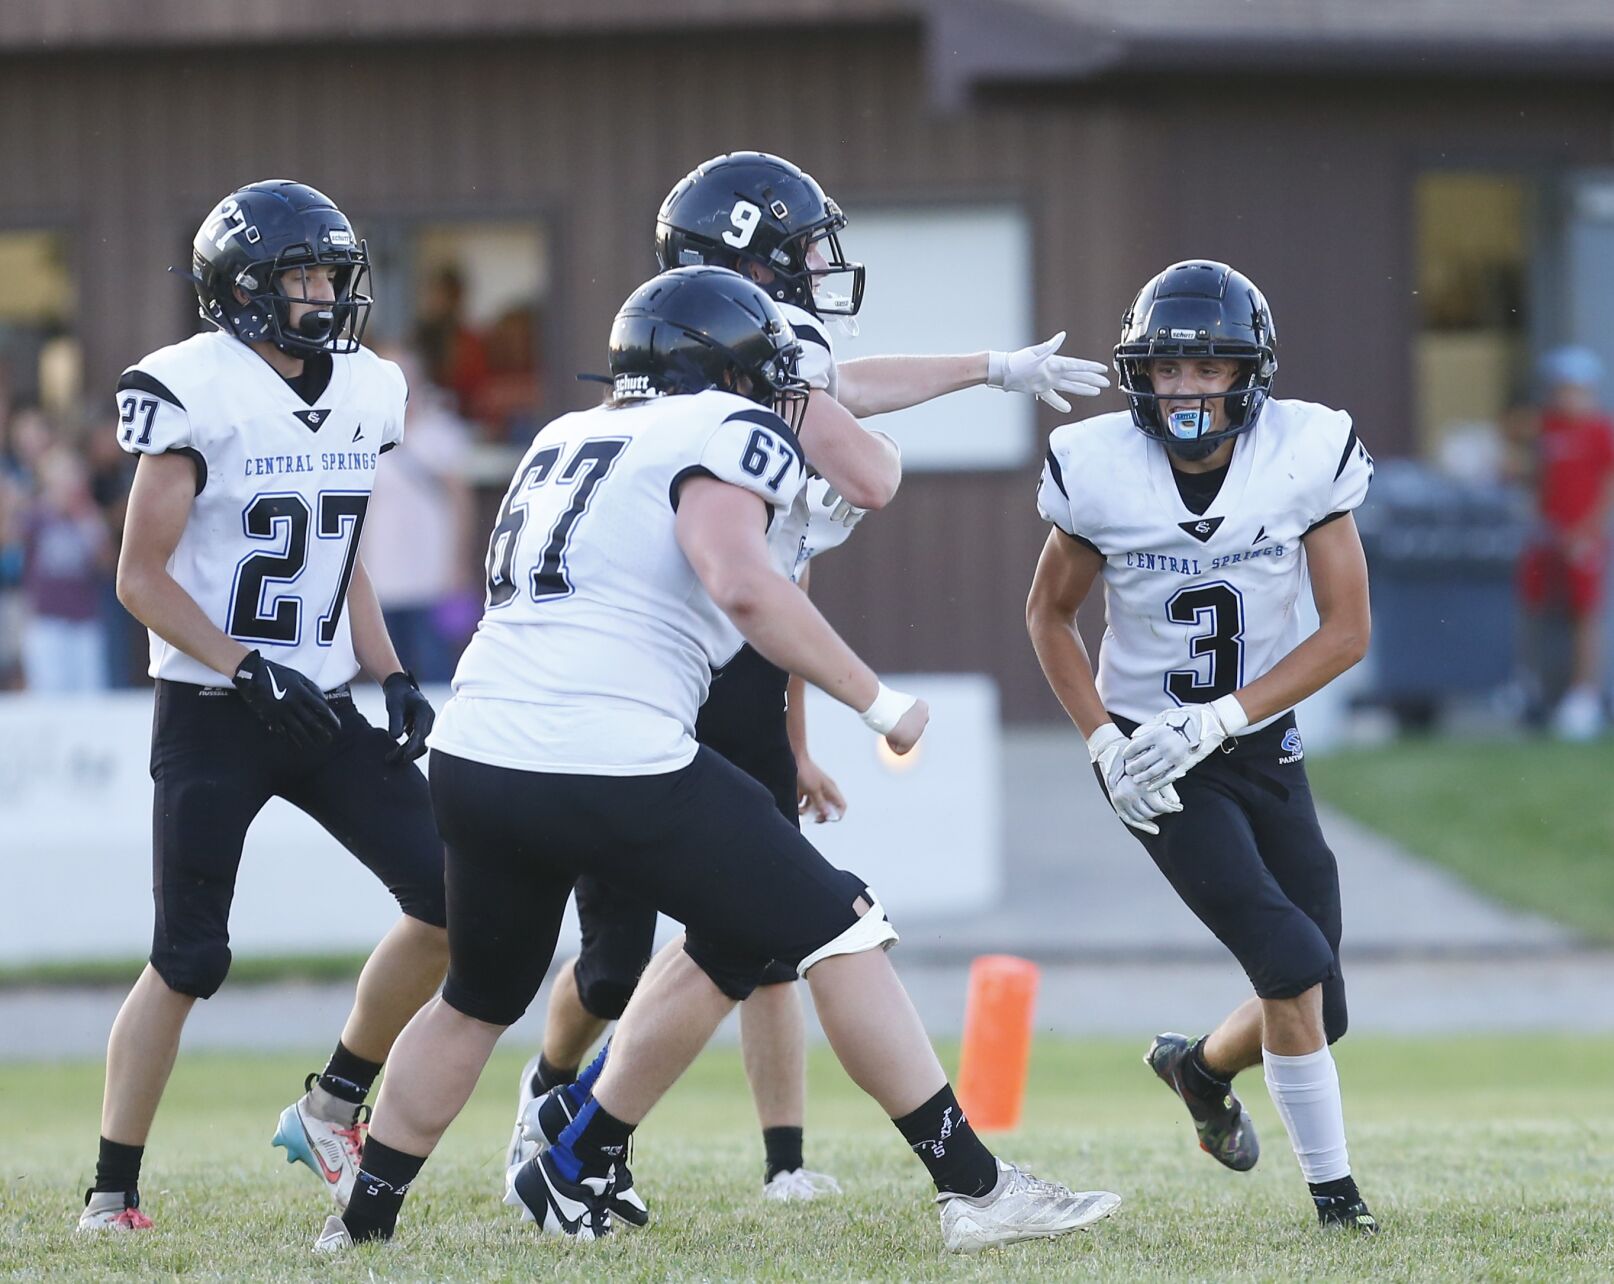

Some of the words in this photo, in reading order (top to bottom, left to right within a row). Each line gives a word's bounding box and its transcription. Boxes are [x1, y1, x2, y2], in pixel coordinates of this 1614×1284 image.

[204, 199, 247, 252] 27
[721, 200, 762, 249] 9
[615, 374, 650, 391] schutt
[121, 396, 160, 446] 27
[245, 455, 313, 476] CENTRAL
[321, 452, 377, 471] SPRINGS
[739, 426, 795, 493] 67
[484, 436, 632, 610] 67
[225, 490, 372, 647] 27
[1127, 551, 1201, 575] CENTRAL
[1212, 545, 1284, 569] SPRINGS
[1164, 580, 1245, 707] 3
